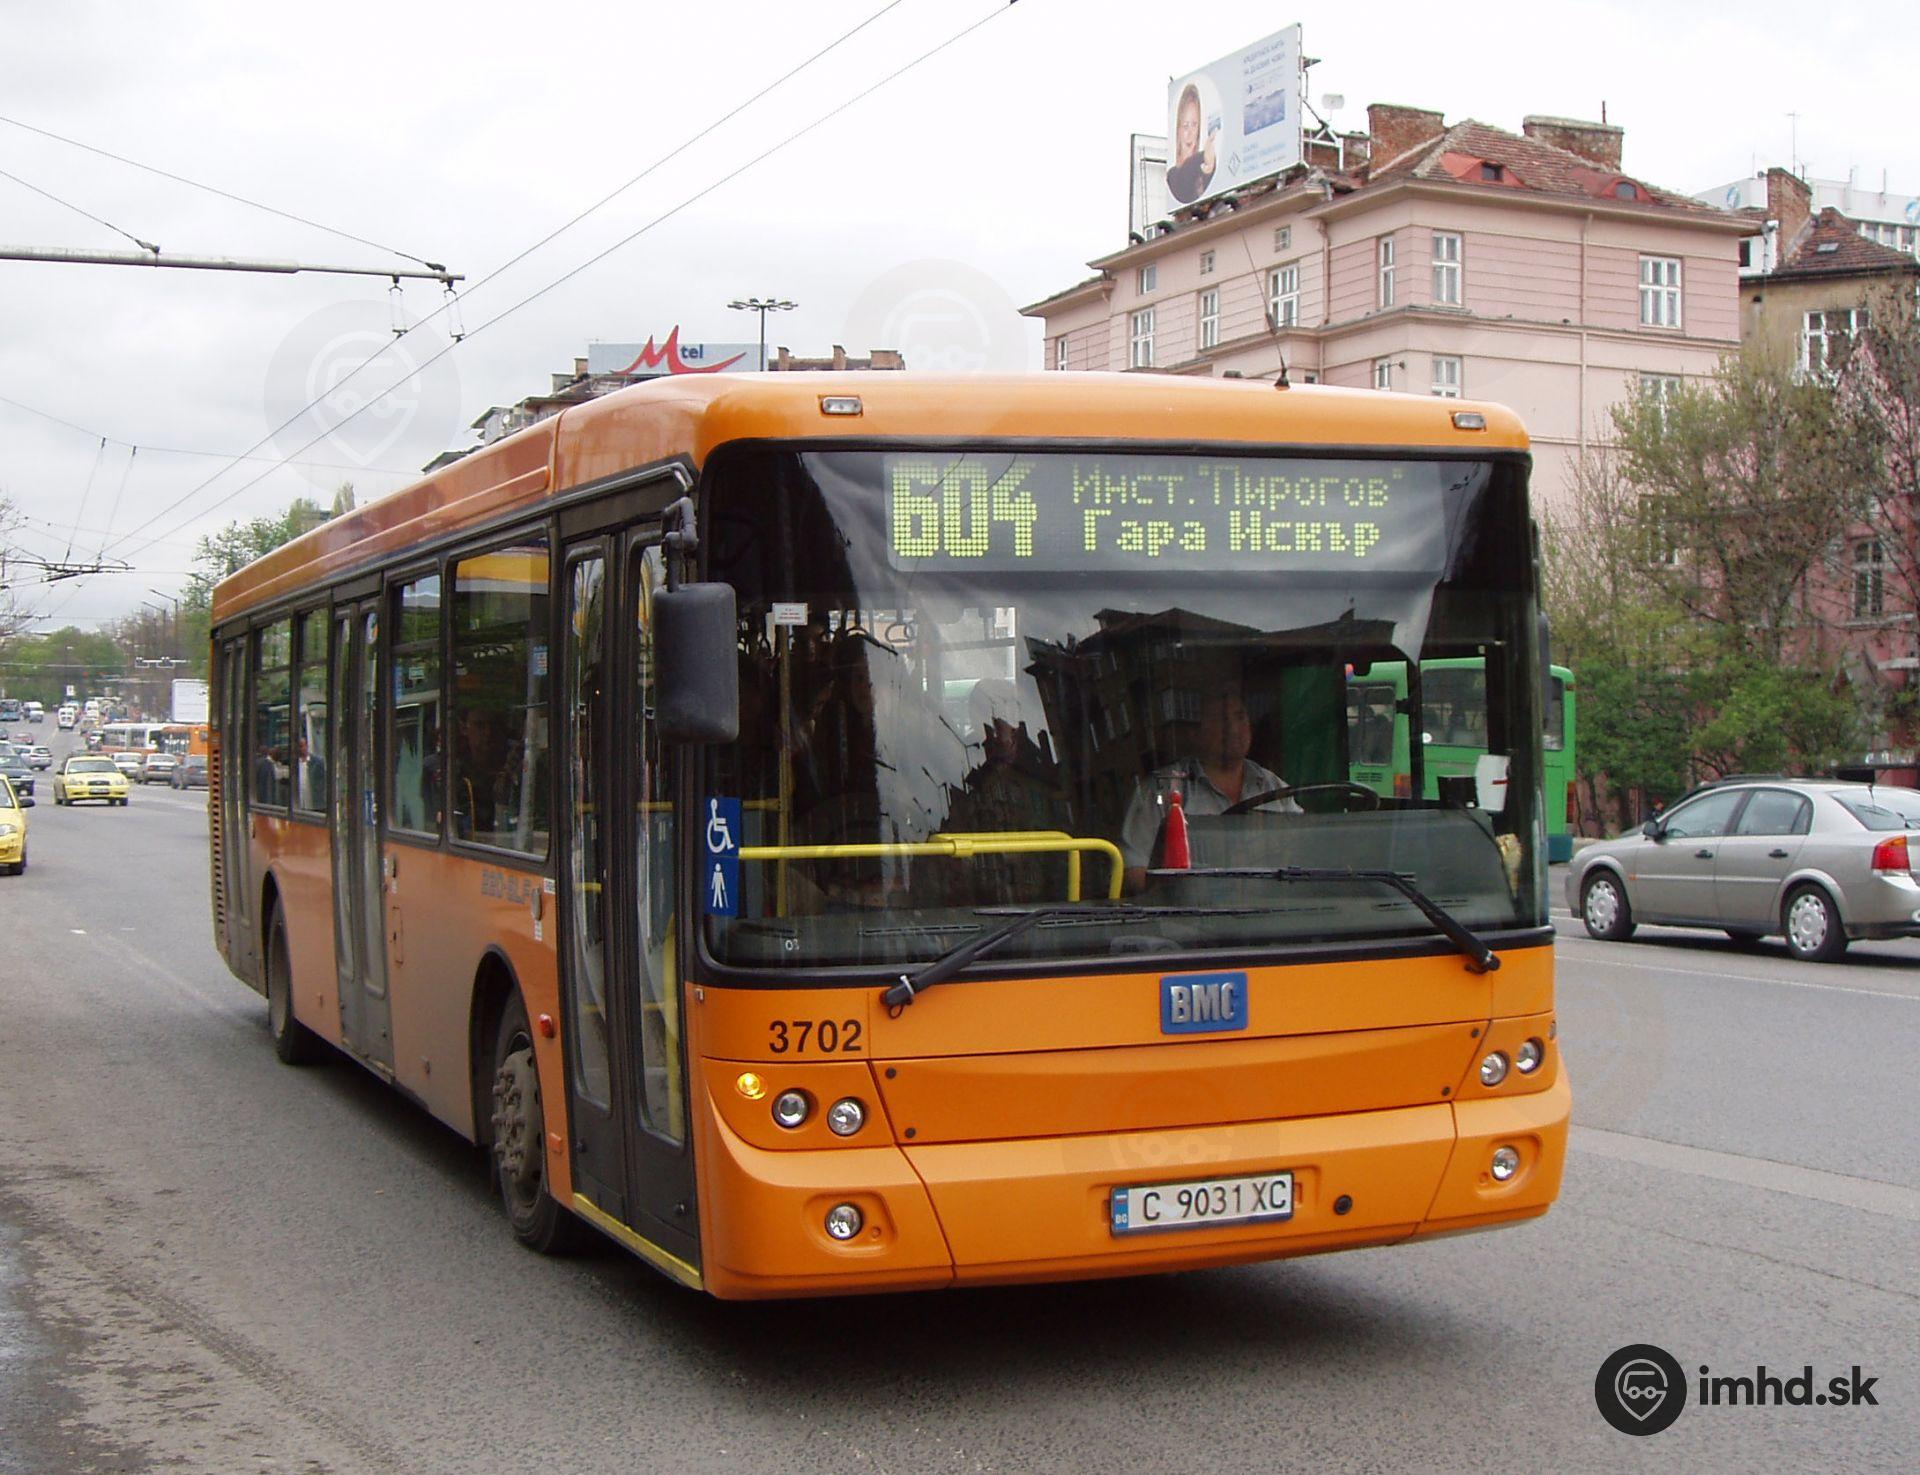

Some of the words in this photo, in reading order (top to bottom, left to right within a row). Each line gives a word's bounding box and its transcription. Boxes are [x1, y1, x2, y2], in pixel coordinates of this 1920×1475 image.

[893, 461, 1038, 557] 604
[1084, 508, 1206, 557] Гара
[1229, 510, 1380, 557] Искър
[1169, 982, 1235, 1024] BMC
[768, 1019, 863, 1054] 3702
